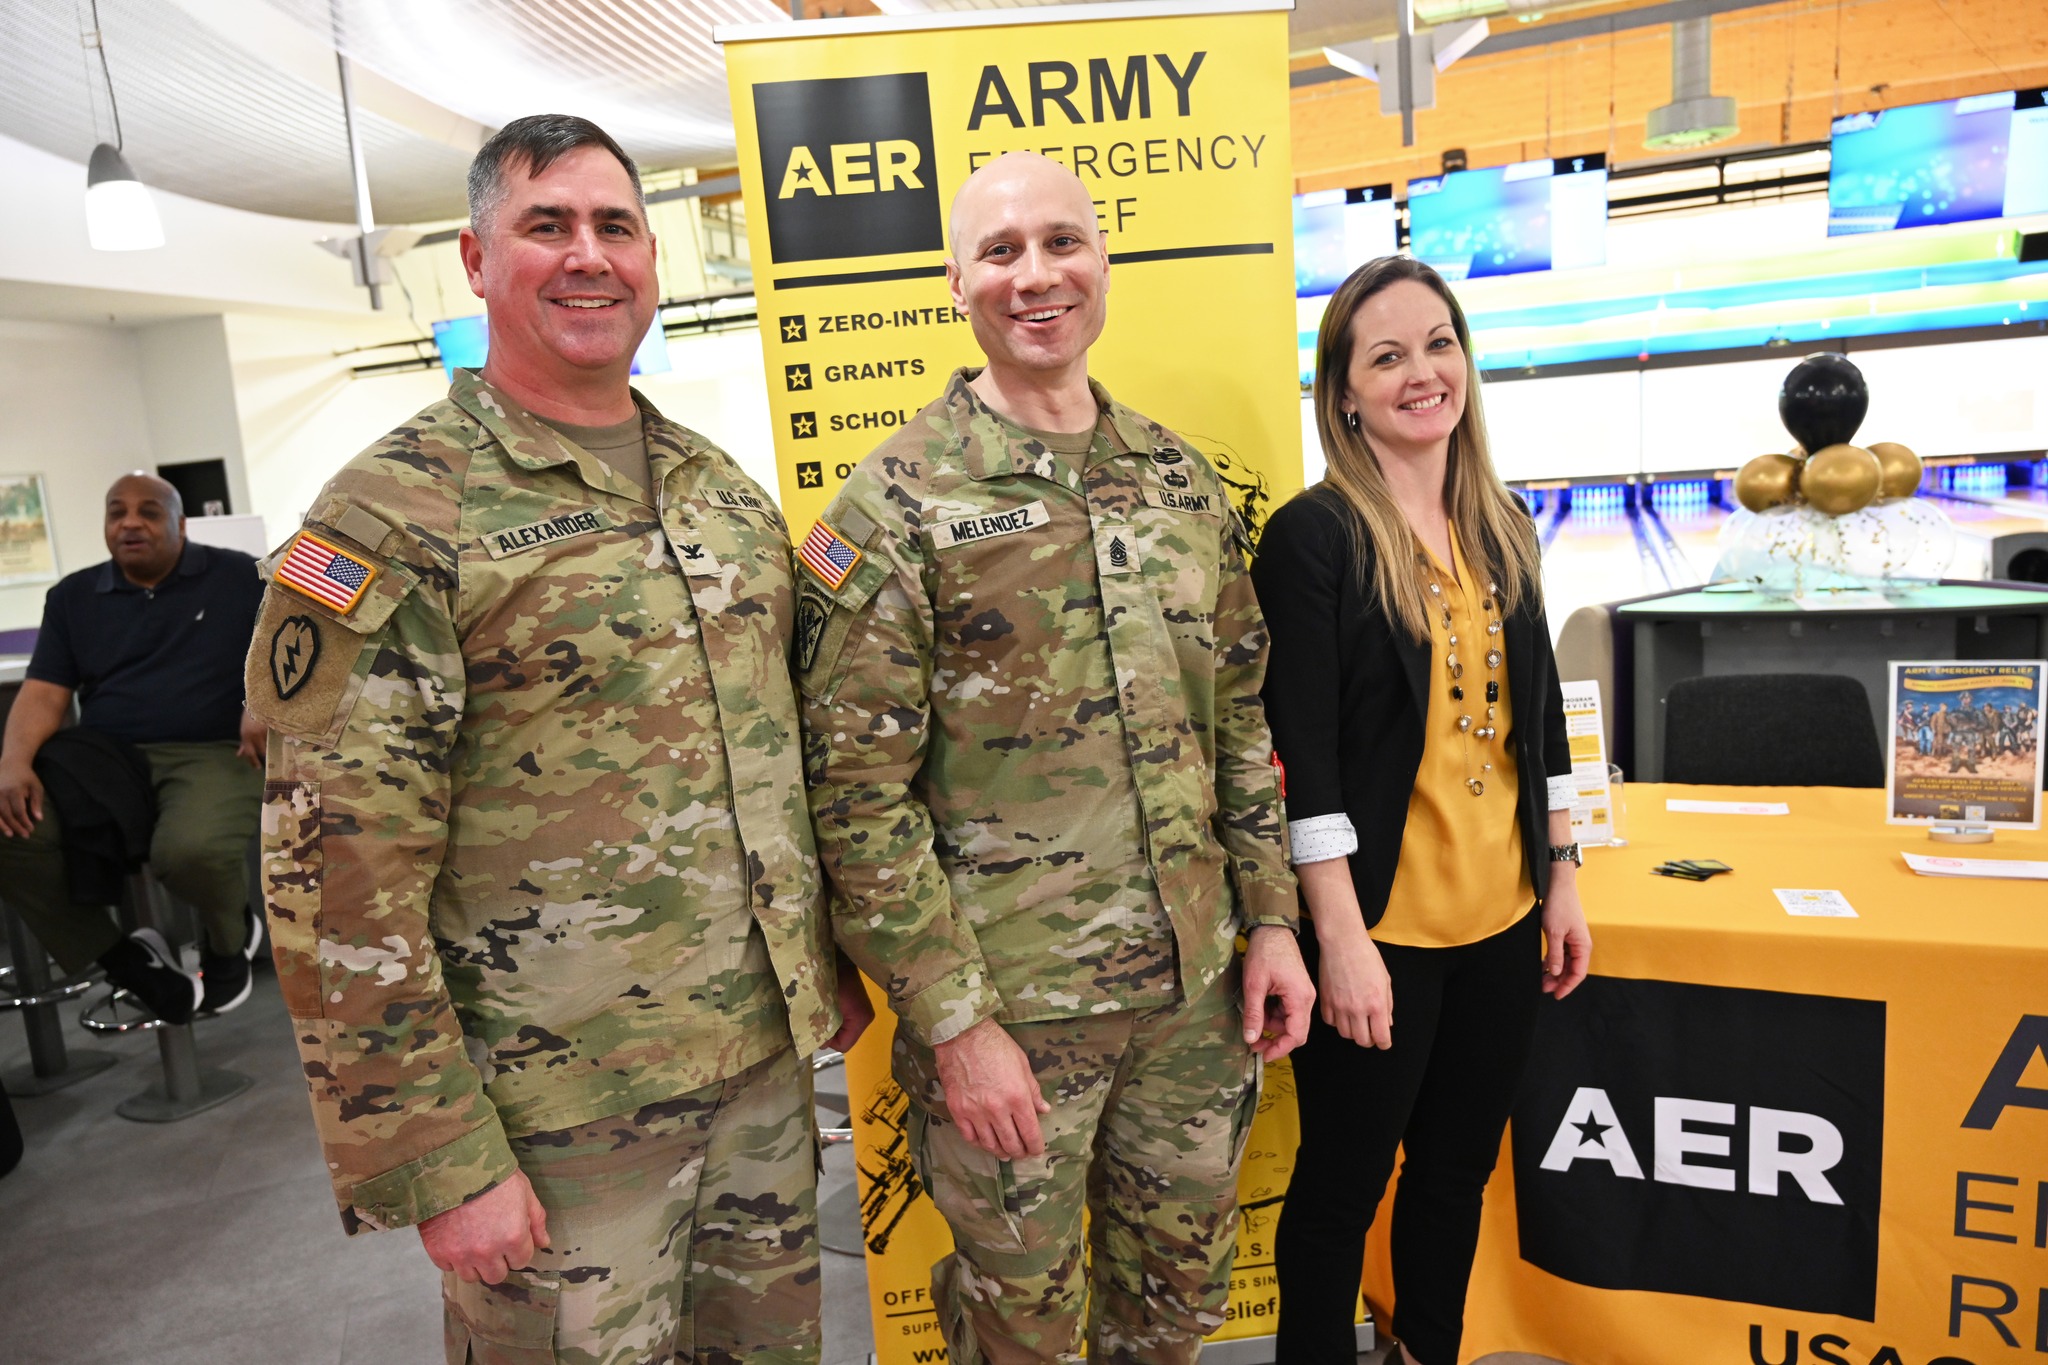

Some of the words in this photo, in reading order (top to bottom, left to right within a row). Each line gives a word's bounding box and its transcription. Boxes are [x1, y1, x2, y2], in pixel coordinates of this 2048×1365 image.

[966, 50, 1208, 131] ARMY
[777, 139, 925, 200] AER
[969, 134, 1266, 179] ERGENCY
[818, 306, 971, 334] ZERO-INTER
[824, 358, 925, 383] GRANTS
[830, 408, 922, 432] SCHOL
[497, 511, 600, 553] ALEXANDER
[950, 508, 1034, 542] MELENDEZ
[1935, 666, 1996, 675] EMERGENCY
[1998, 666, 2034, 675] RELIEF
[1540, 1086, 1845, 1206] AER
[884, 1287, 934, 1306] OFFI
[1253, 1275, 1277, 1288] SIN
